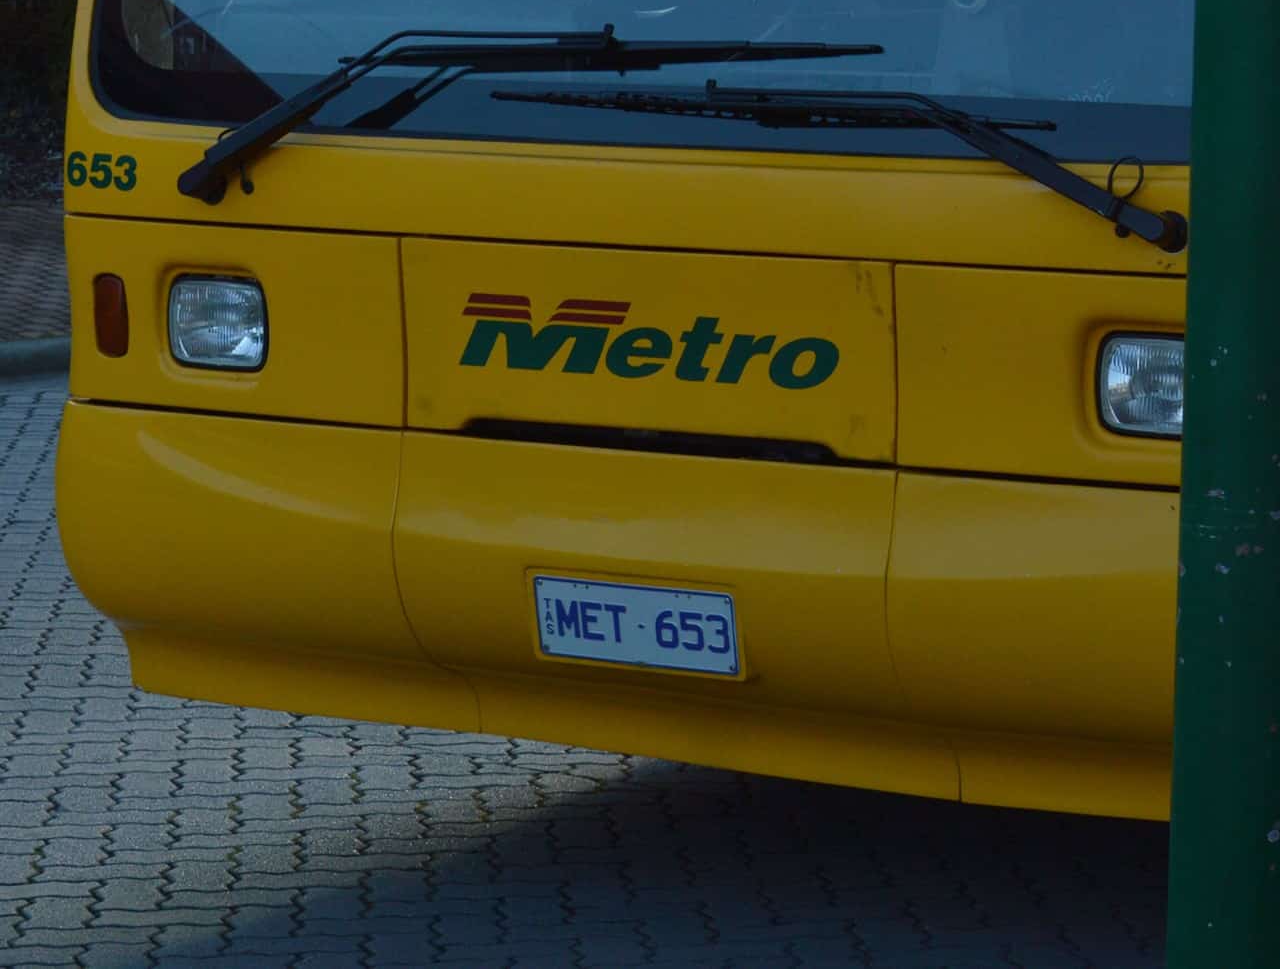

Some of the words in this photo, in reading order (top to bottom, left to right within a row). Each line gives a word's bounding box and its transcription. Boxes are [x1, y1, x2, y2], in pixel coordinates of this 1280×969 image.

[67, 150, 138, 192] 653
[458, 291, 841, 391] Metro
[543, 597, 555, 636] TAS
[555, 598, 627, 644] MET
[655, 609, 731, 655] 653
